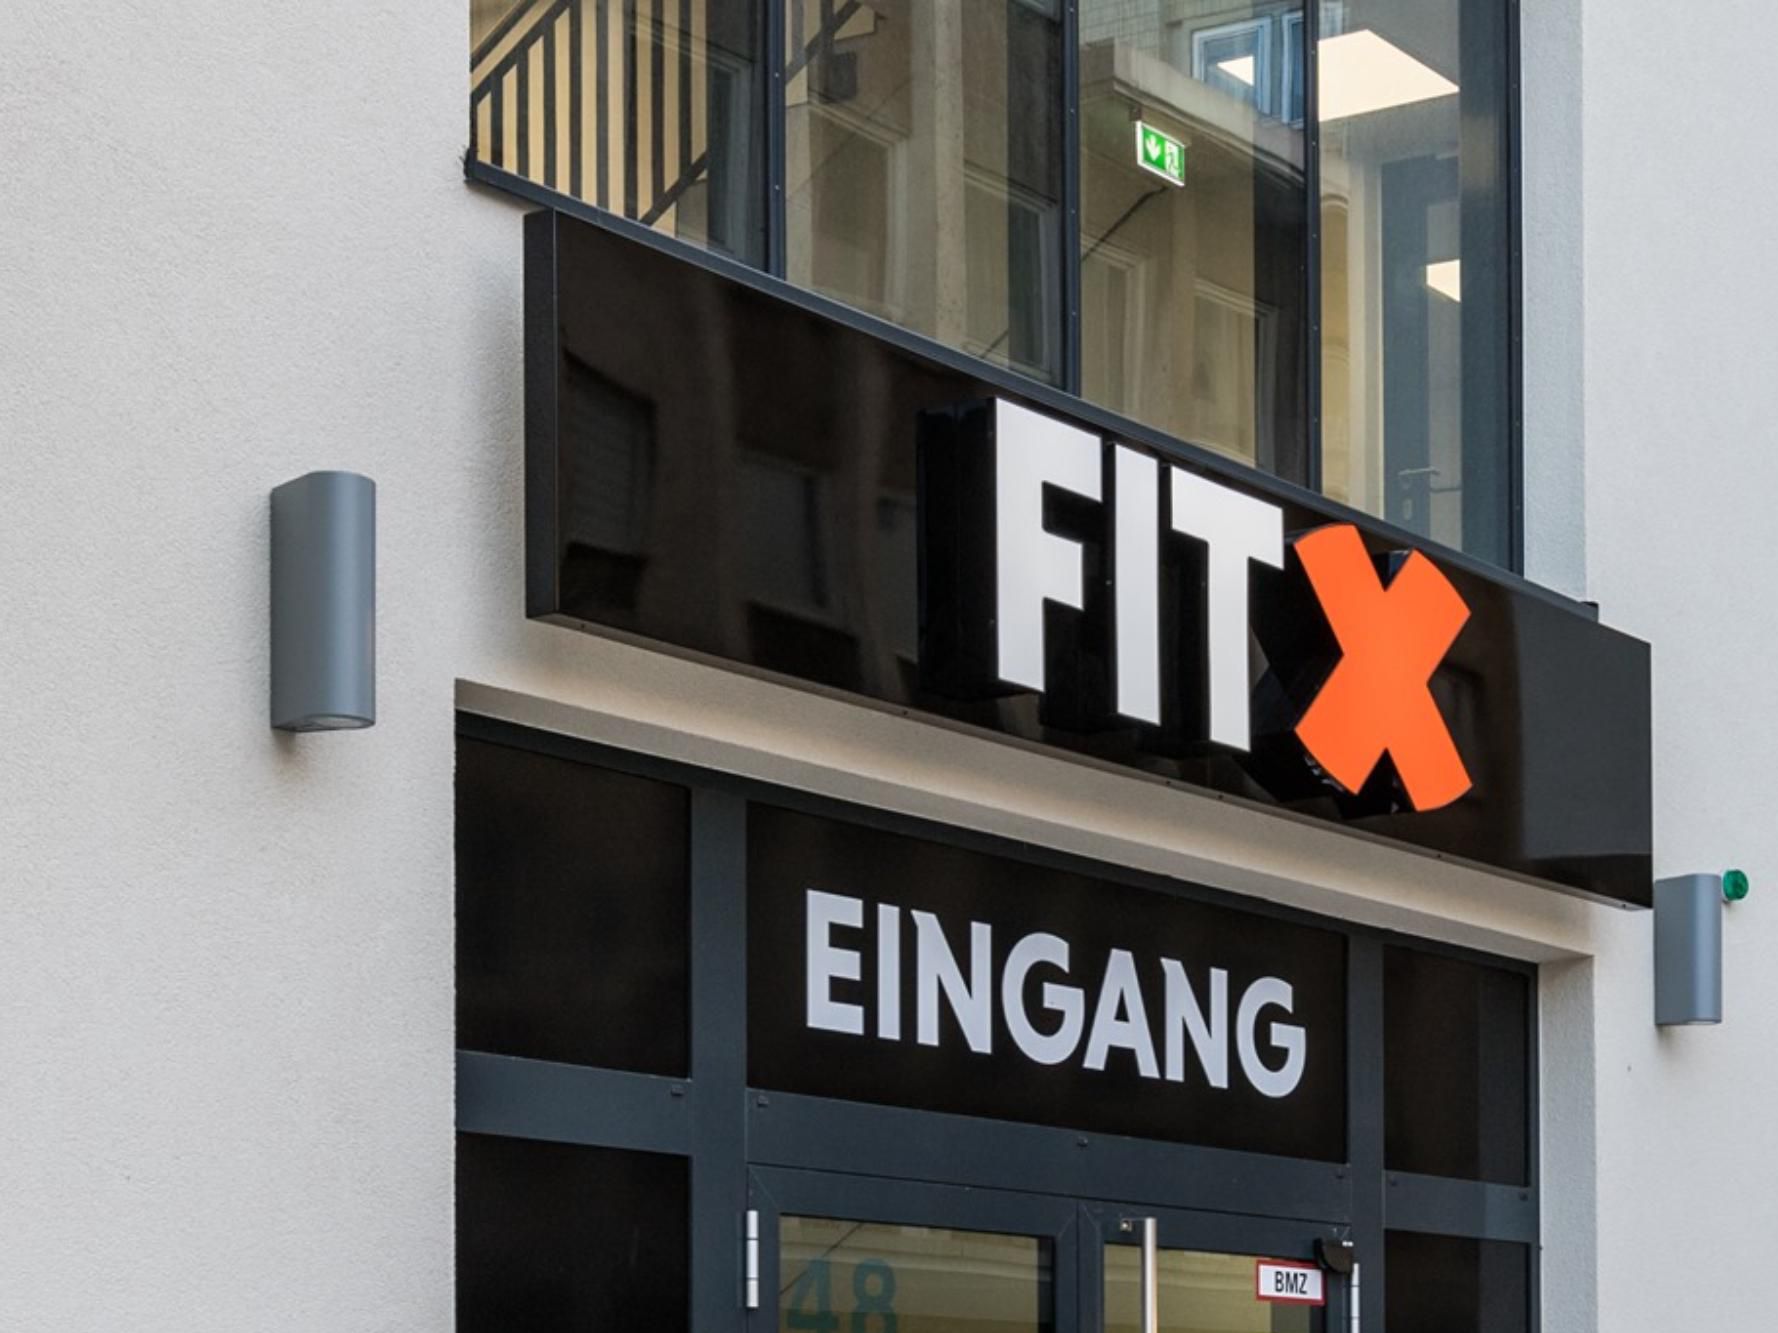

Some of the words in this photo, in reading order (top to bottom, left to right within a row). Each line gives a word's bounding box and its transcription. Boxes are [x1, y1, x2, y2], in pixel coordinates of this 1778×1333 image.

[996, 397, 1473, 812] FITX
[806, 888, 1306, 1099] EINGANG
[1274, 1271, 1307, 1295] BMZ
